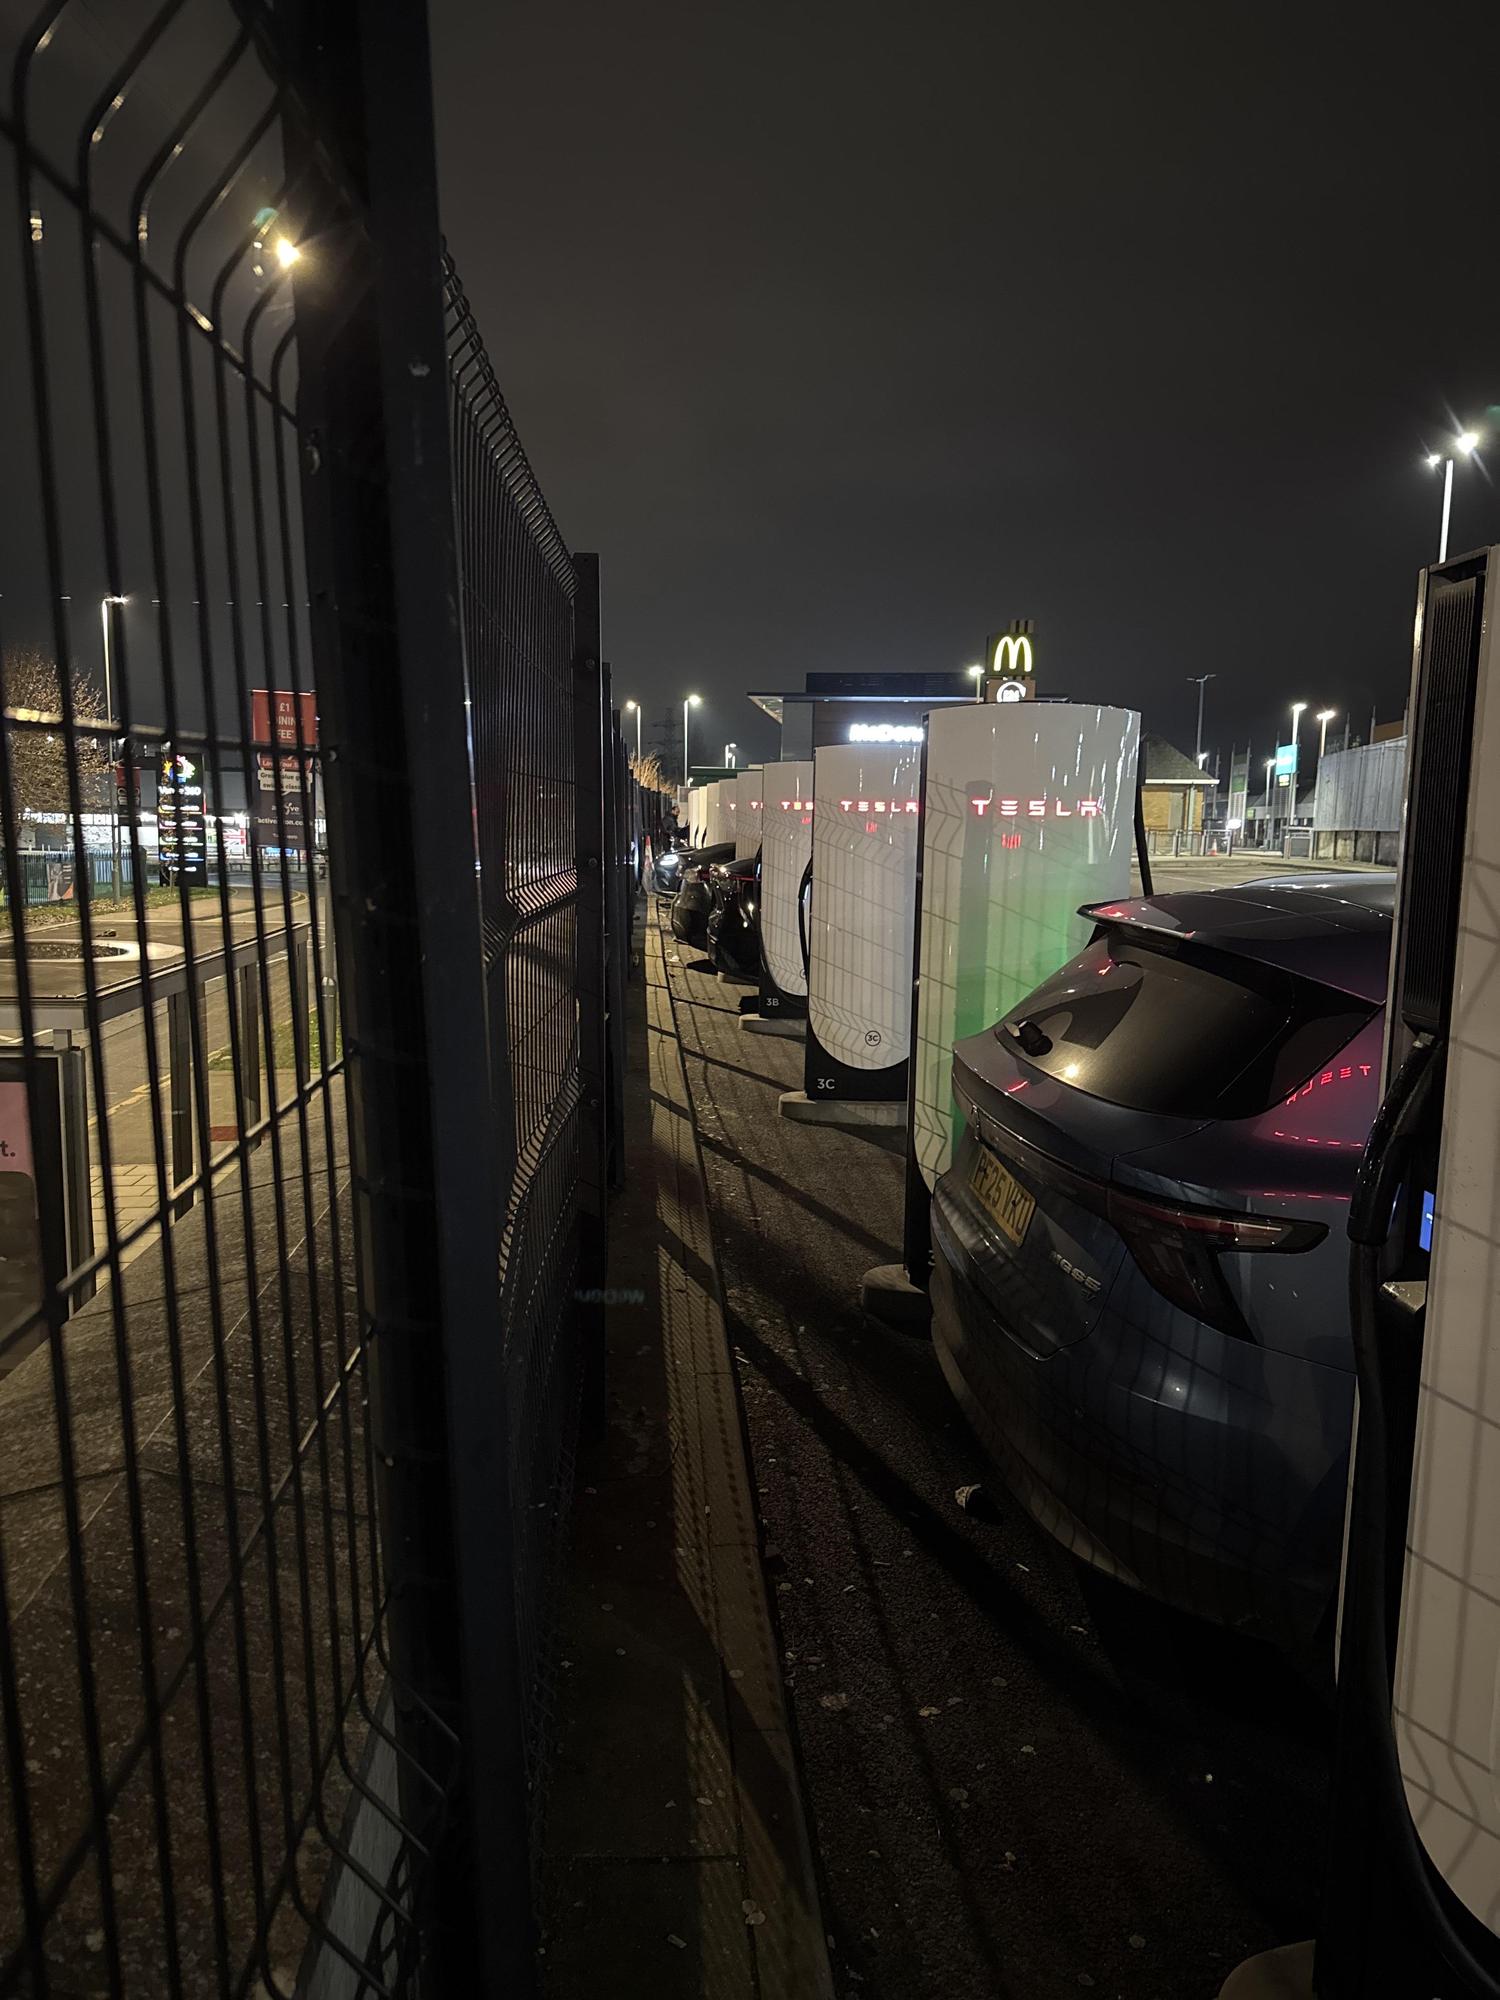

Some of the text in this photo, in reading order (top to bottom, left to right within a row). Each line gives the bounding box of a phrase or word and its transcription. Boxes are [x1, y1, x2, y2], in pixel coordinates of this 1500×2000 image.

[280, 703, 289, 712] £1
[840, 800, 918, 813] TESLA
[971, 799, 1098, 816] TESLA
[766, 998, 780, 1007] 3B
[867, 1034, 879, 1042] 3C
[817, 1078, 836, 1090] 3C
[973, 1150, 1008, 1208] PF25
